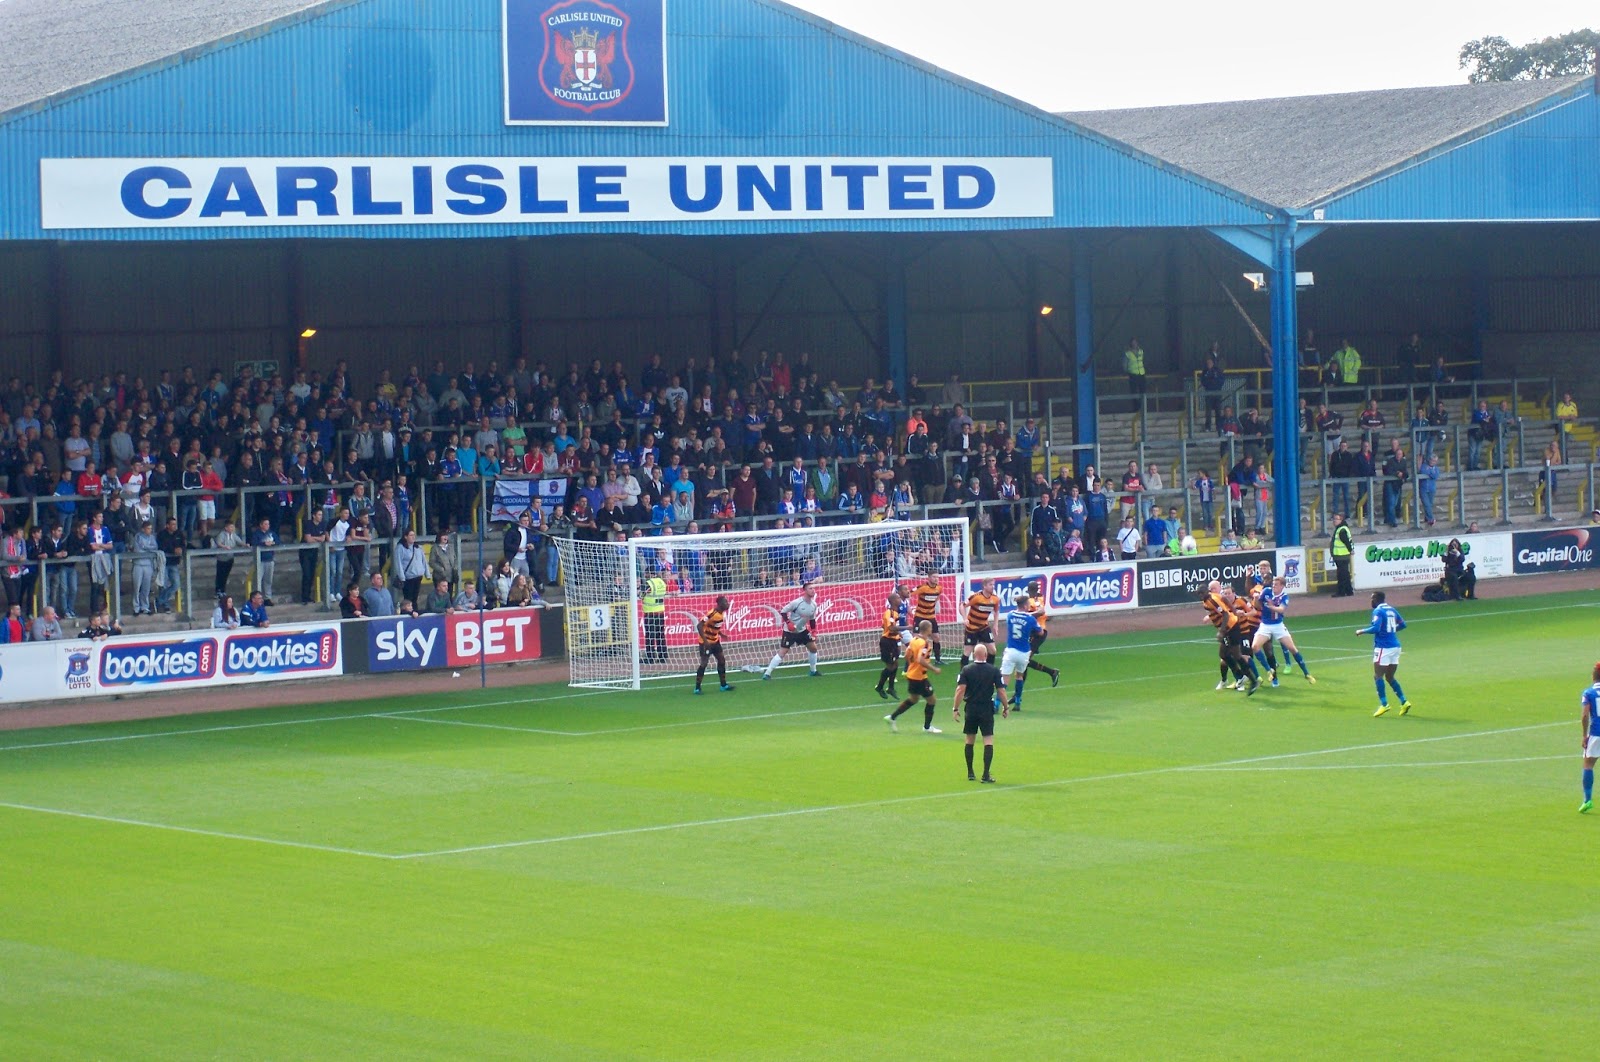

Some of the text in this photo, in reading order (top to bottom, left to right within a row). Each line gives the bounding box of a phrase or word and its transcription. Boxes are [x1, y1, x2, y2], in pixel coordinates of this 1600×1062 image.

[548, 12, 623, 27] CARLISLE UNITED
[554, 87, 599, 101] FOOTBALL
[599, 88, 621, 100] CLUB
[120, 164, 996, 220] CARLISLE UNITED
[1365, 540, 1471, 563] Graeme Hoe
[1054, 576, 1120, 602] bookies
[1121, 574, 1129, 597] .com
[1142, 569, 1182, 590] BBC
[1184, 567, 1220, 583] RADIO
[594, 608, 604, 628] 3
[724, 599, 751, 632] Virgin
[743, 615, 774, 629] trains
[825, 609, 856, 622] trains
[1386, 616, 1398, 633] 14
[455, 616, 531, 657] BET
[663, 623, 692, 635] rains
[1011, 623, 1023, 640] 5
[228, 638, 318, 670] bookies
[322, 635, 330, 663] .com
[376, 620, 438, 667] sky
[105, 648, 197, 680] bookies
[201, 644, 210, 673] .com
[69, 676, 91, 684] BLUES'
[69, 682, 91, 690] LOTTO
